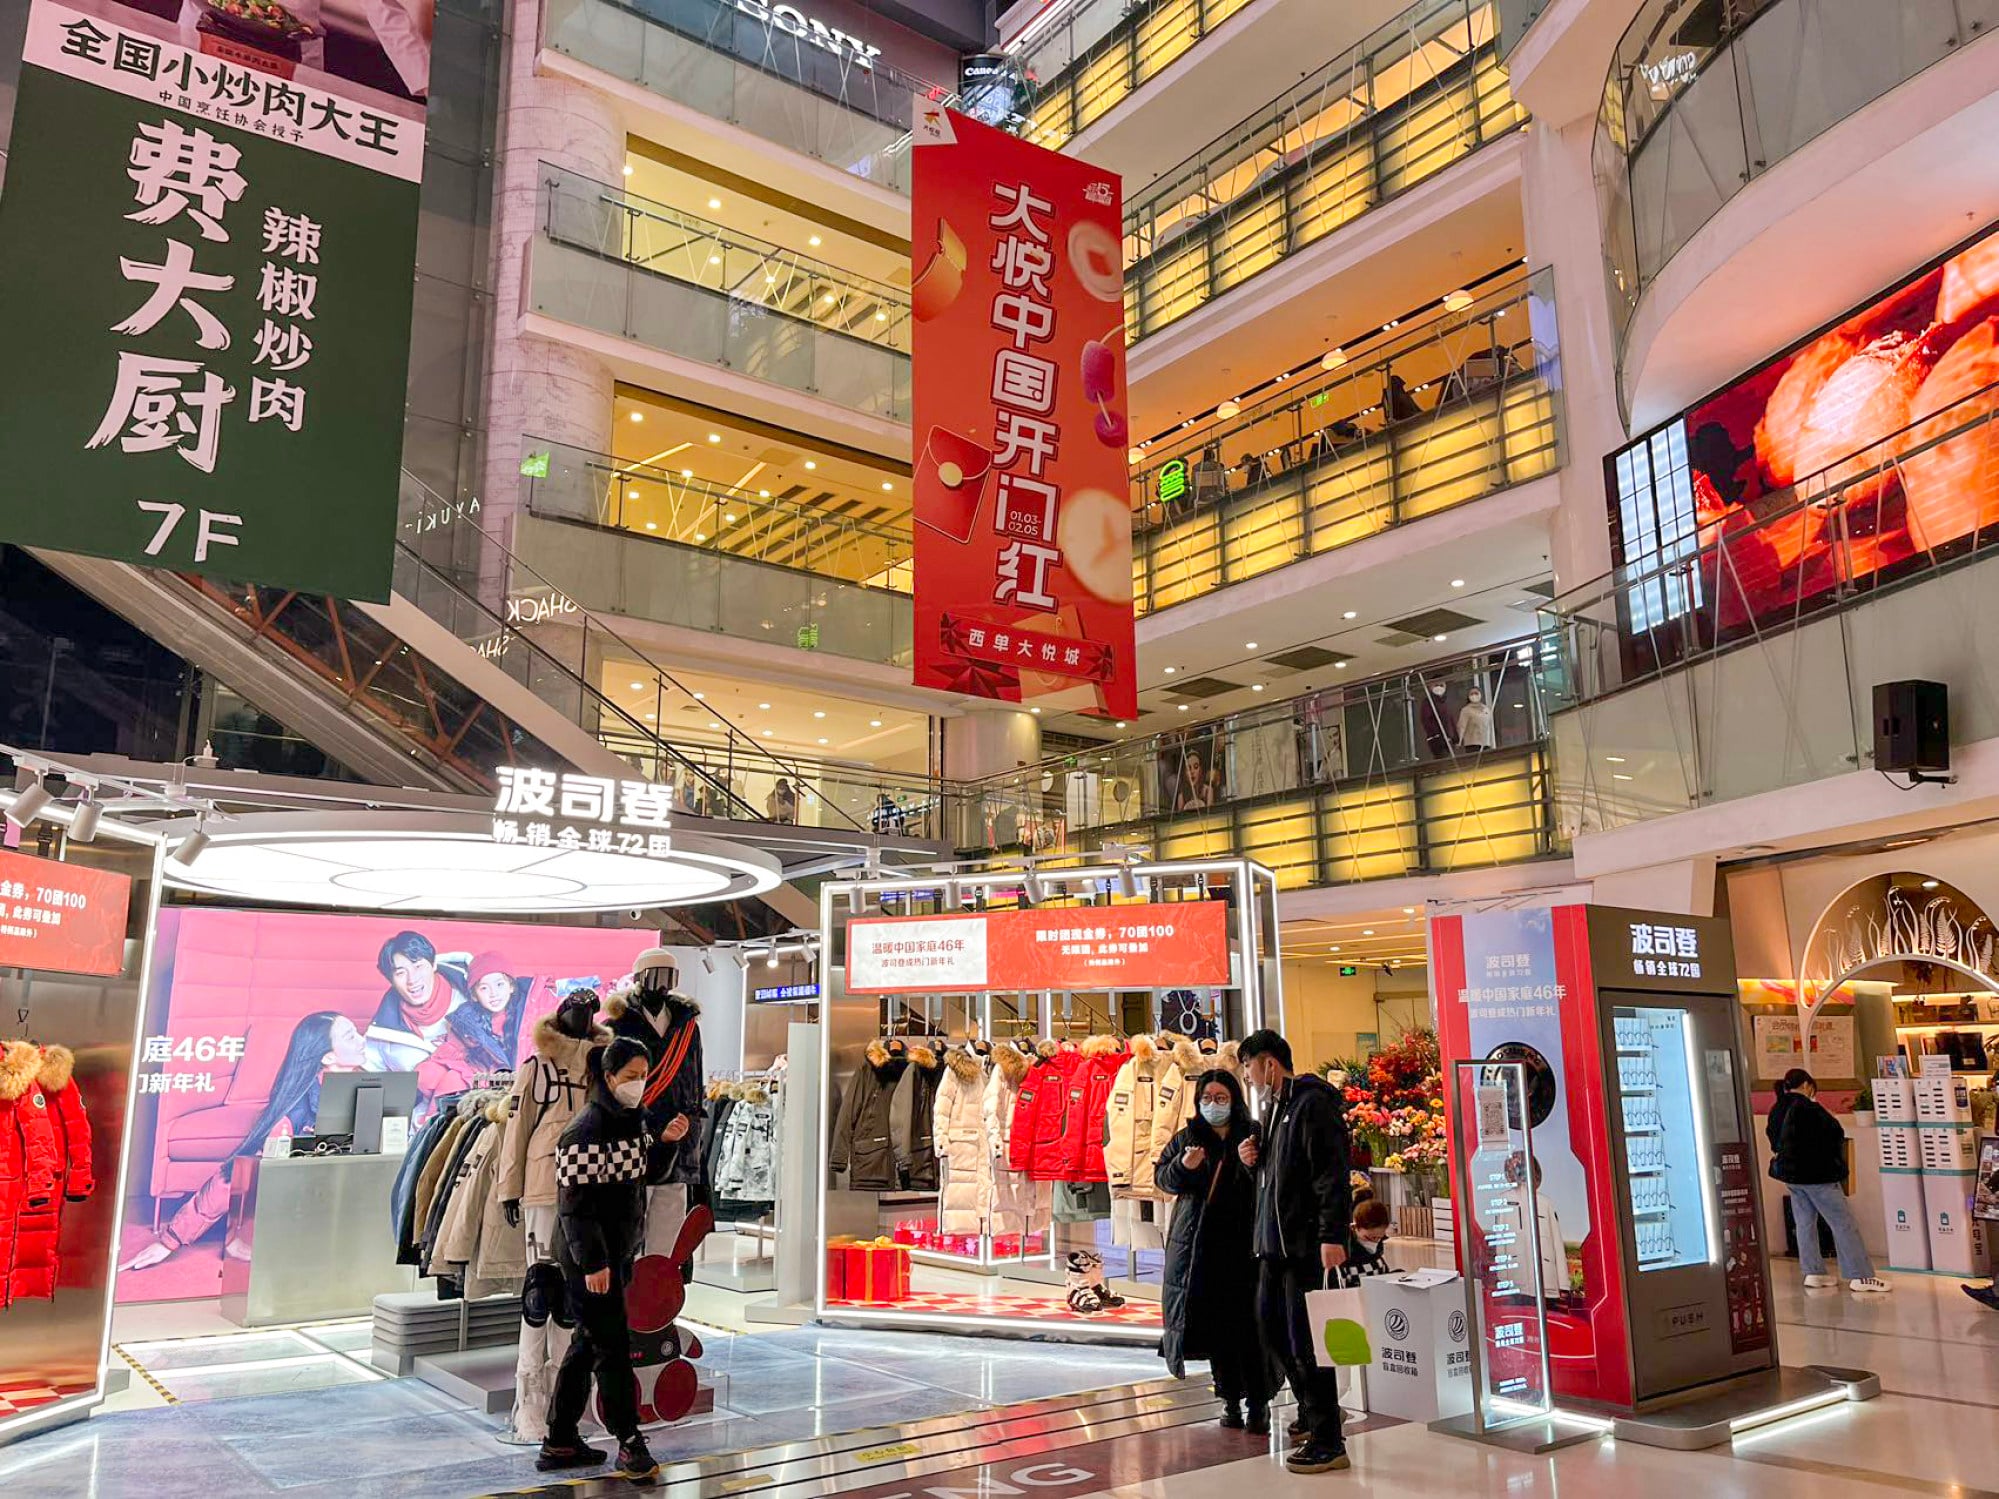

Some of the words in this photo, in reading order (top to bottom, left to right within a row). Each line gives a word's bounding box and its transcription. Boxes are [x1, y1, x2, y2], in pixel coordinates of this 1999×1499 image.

[60, 18, 399, 156] 全国小炒肉大王
[159, 89, 304, 144] 中国烹饪协会授予
[84, 119, 249, 473] 费大厨
[248, 206, 321, 431] 辣椒炒肉
[991, 181, 1061, 608] 大悦中国开门红
[138, 500, 243, 563] 7F
[1009, 521, 1038, 536] 02.05
[969, 628, 1081, 666] 西单大悦城
[494, 766, 674, 829] 波司登
[492, 818, 672, 858] 畅销全球72国
[872, 939, 965, 955] 温暖中国家庭46年
[1629, 923, 1699, 958] 波司登
[1485, 954, 1531, 969] 波司登
[1633, 959, 1701, 978] 畅销全球72国
[1458, 984, 1567, 1003] 温暖中国家庭46年
[142, 1035, 246, 1063] 庭46年
[1382, 1346, 1417, 1364] 波司登
